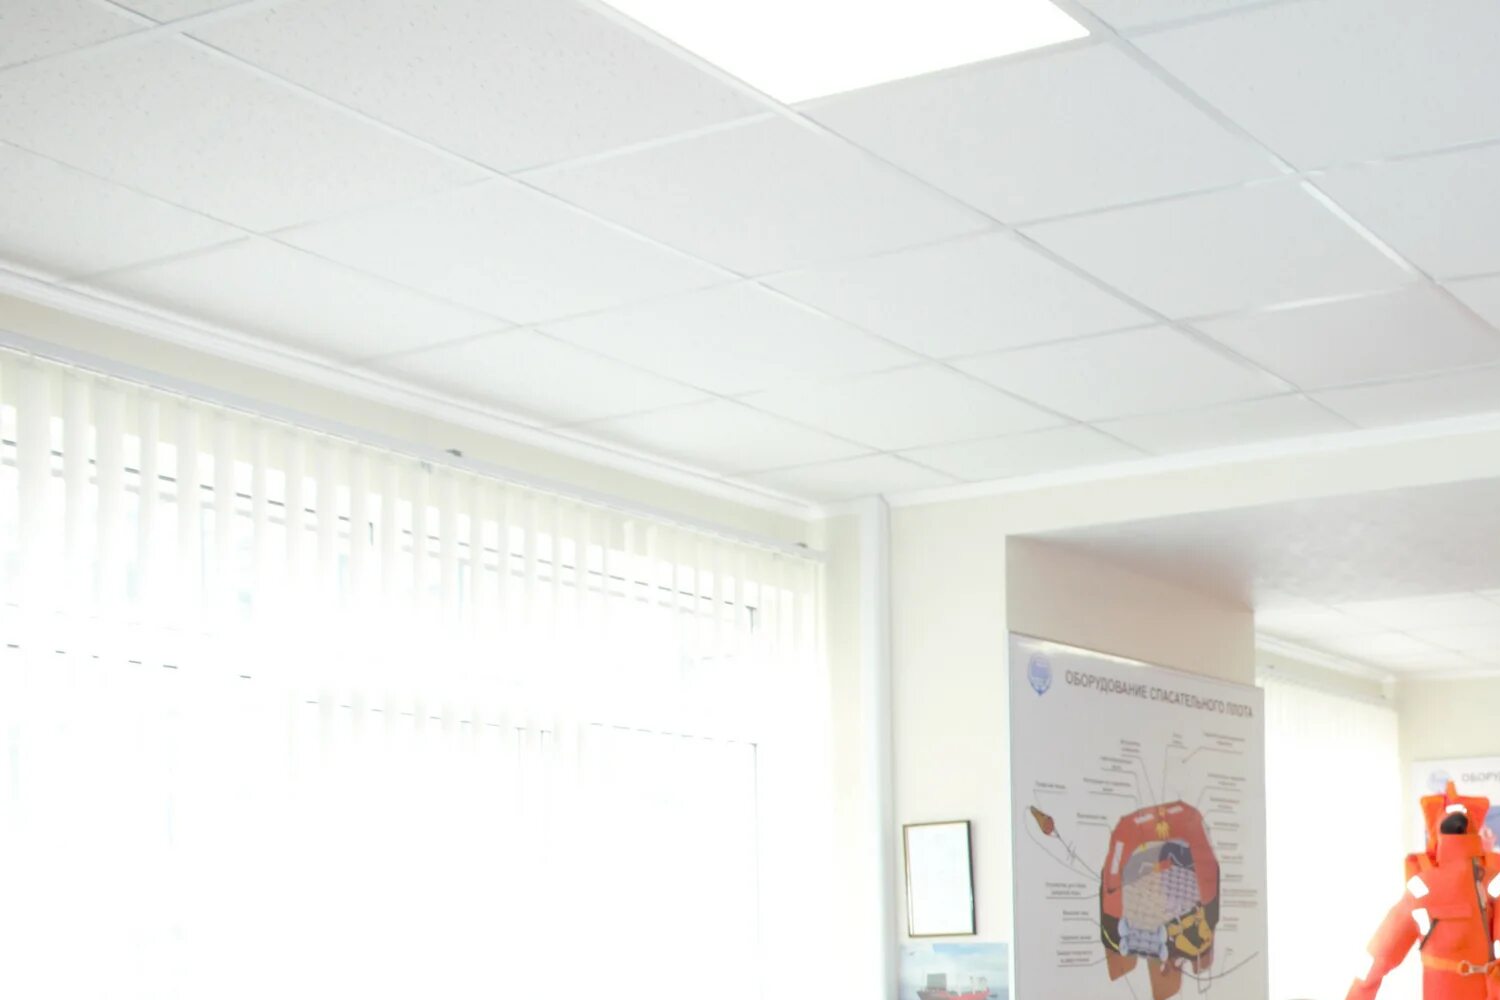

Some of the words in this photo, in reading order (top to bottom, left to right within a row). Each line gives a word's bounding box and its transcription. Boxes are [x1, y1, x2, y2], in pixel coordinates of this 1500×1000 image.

[1065, 670, 1147, 698] ОБОРУДОВАНИЕ
[1150, 687, 1225, 713] СПАСАТЕЛЬНОГО
[1226, 700, 1254, 718] ПЛОТА
